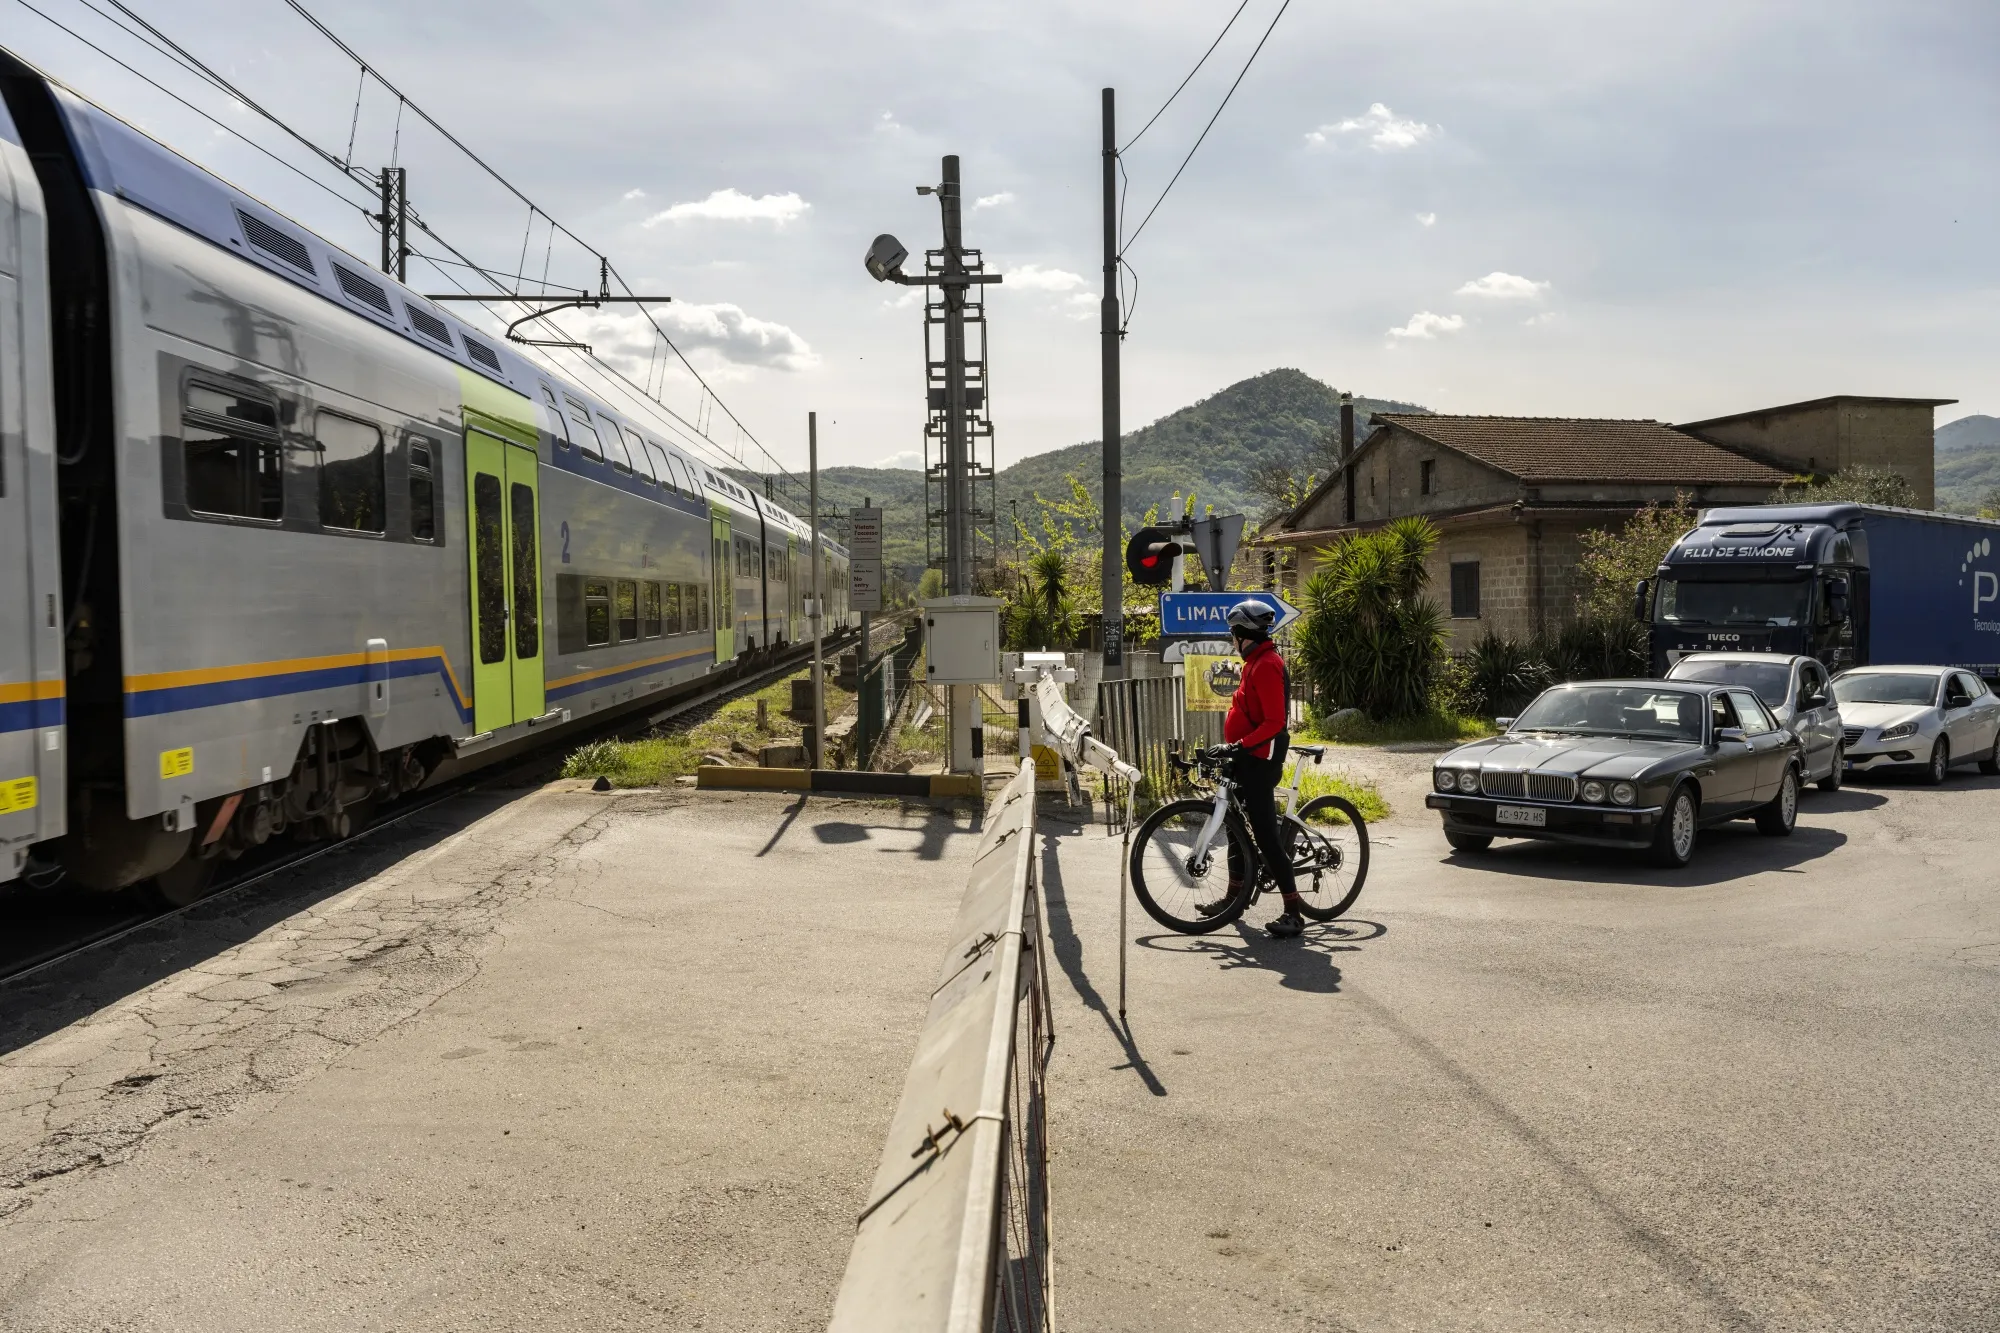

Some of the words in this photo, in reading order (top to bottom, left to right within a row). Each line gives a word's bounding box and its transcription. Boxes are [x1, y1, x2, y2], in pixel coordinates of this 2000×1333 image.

[560, 520, 570, 563] 2
[1683, 548, 1714, 558] F.LLI
[1715, 547, 1736, 557] DE
[1738, 546, 1795, 557] SIMONE
[1973, 570, 1999, 614] P
[1177, 606, 1230, 621] LIMAT
[1707, 633, 1740, 642] IVECO
[1677, 643, 1771, 652] STRALIS
